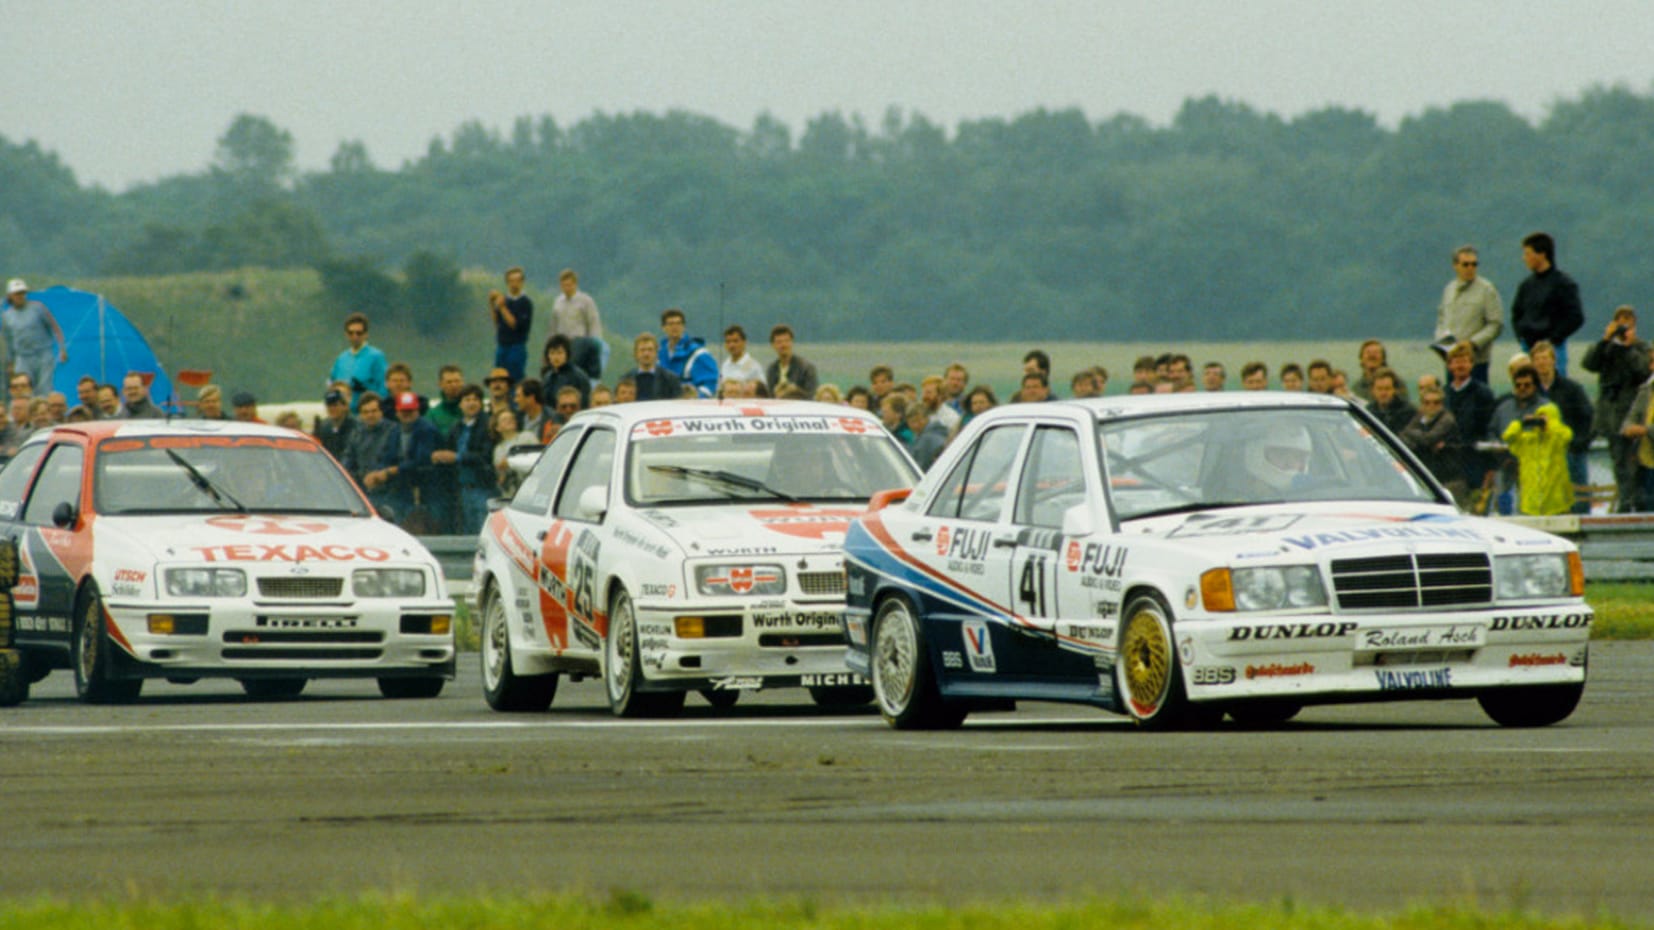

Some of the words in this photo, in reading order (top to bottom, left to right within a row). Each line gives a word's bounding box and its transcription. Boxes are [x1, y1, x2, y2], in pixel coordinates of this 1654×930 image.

[750, 418, 830, 434] Original
[948, 527, 992, 561] FUJI
[1281, 527, 1483, 550] VALVOLINE
[191, 544, 390, 563] TEXACO
[1080, 541, 1128, 578] FUJI
[1019, 553, 1047, 619] 41
[256, 614, 358, 628] PIRELLI
[1487, 613, 1593, 631] DUNLOP
[1227, 622, 1359, 642] DUNLOP
[1365, 629, 1431, 648] Roland
[1438, 623, 1478, 643] Asch
[1193, 666, 1237, 686] BBS
[1374, 667, 1452, 689] VALVOLINE
